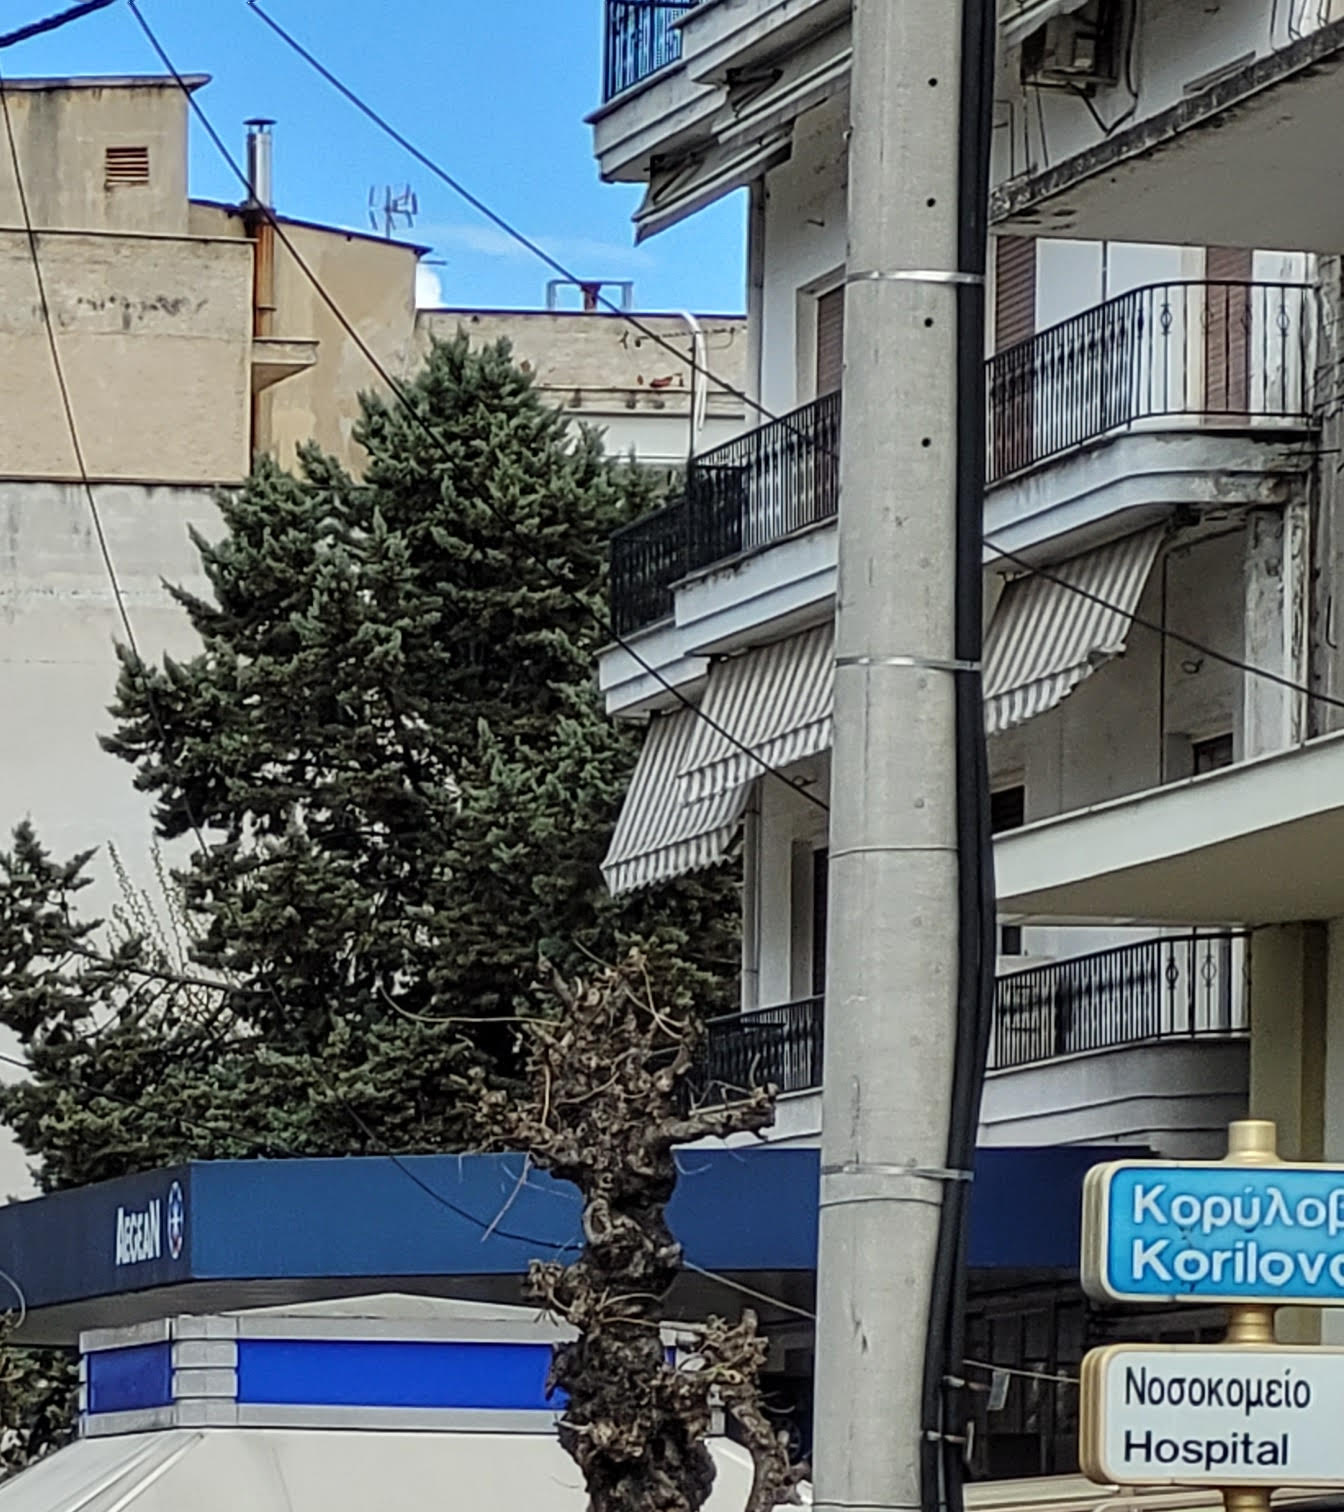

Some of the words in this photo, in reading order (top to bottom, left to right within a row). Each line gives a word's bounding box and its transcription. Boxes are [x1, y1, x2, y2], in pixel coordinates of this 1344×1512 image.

[115, 1199, 160, 1266] AEGEAN
[1124, 1366, 1311, 1416] Νοσοκομείο
[1123, 1430, 1289, 1471] Hospital
